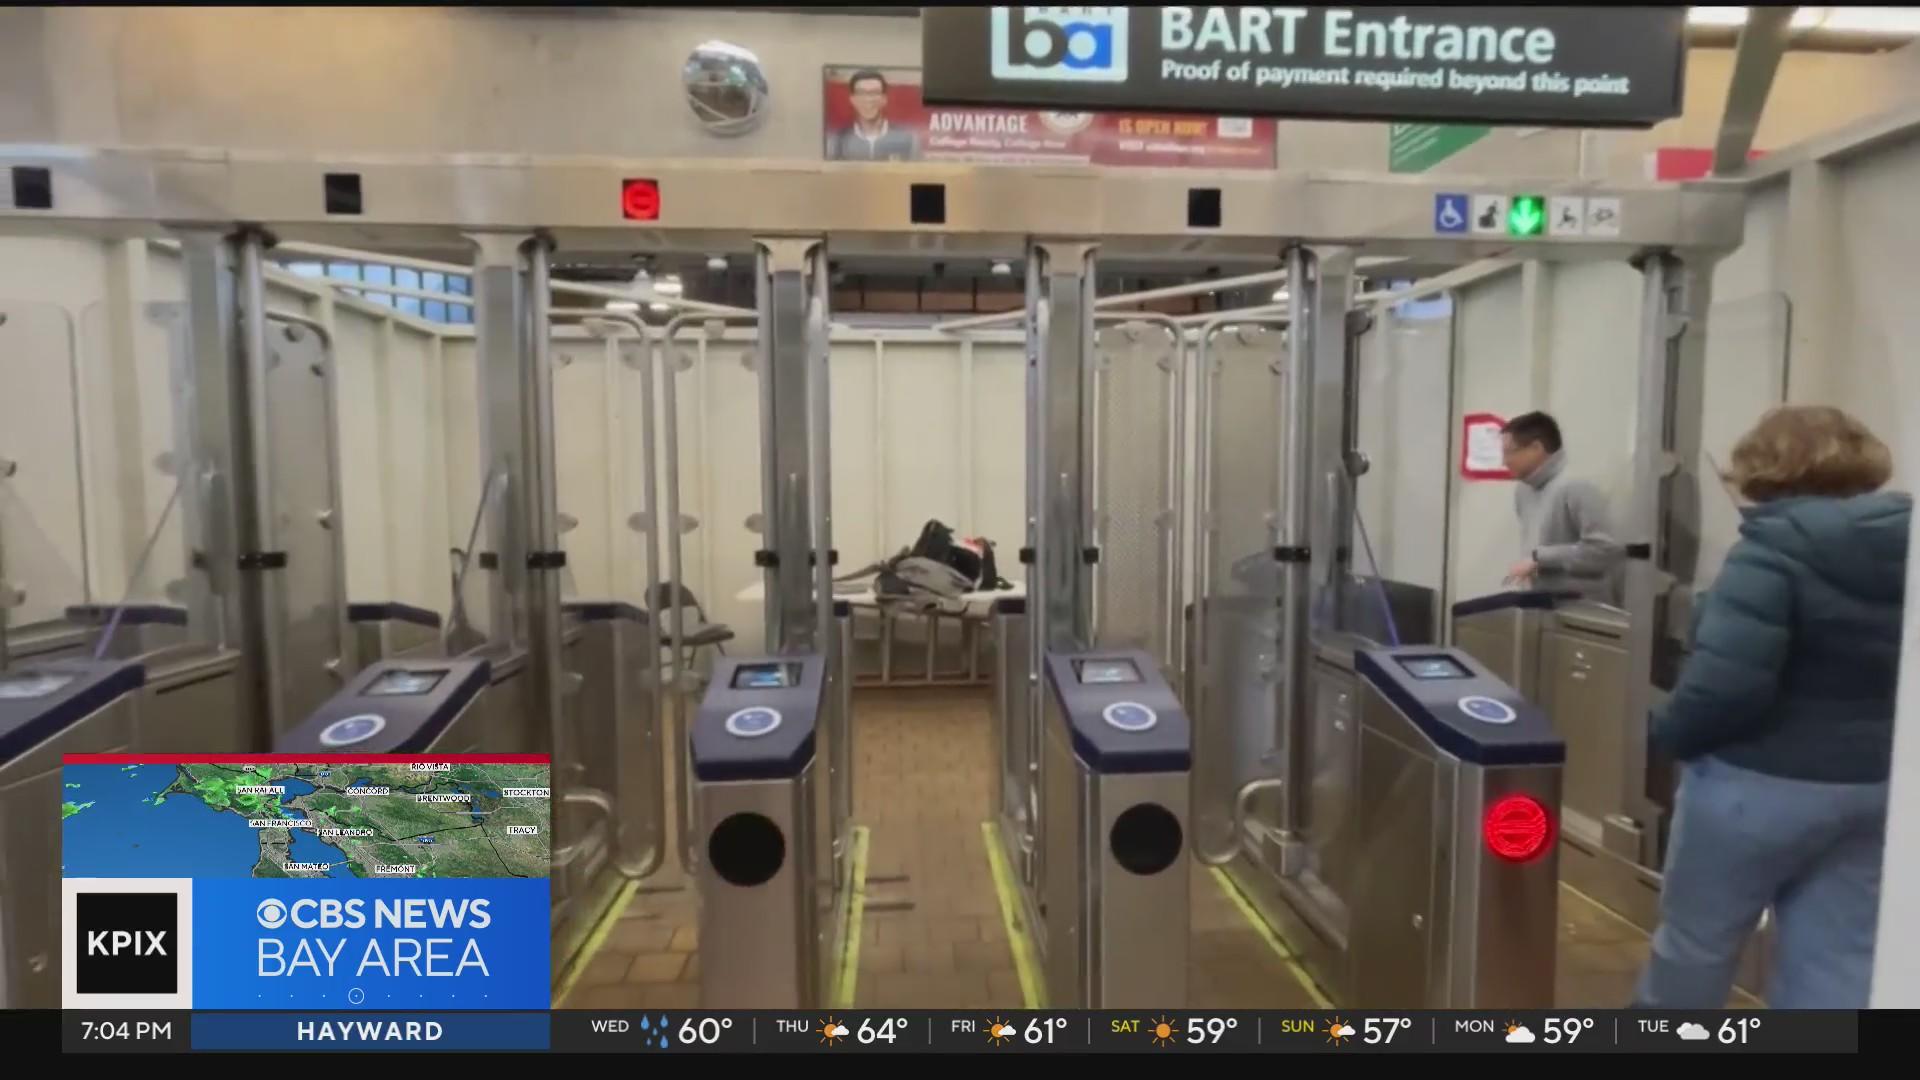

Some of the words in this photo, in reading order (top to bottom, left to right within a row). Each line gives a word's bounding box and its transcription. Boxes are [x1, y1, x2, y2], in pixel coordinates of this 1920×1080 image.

[1161, 7, 1307, 53] BART
[1324, 9, 1556, 64] Entrance
[1161, 59, 1222, 80] Proof
[1226, 60, 1250, 81] of
[1256, 66, 1349, 87] payment
[1355, 67, 1444, 91] required
[1449, 69, 1527, 94] beyond
[1532, 72, 1569, 92] this
[1574, 74, 1630, 97] point
[929, 113, 1029, 133] ADVANTAGE
